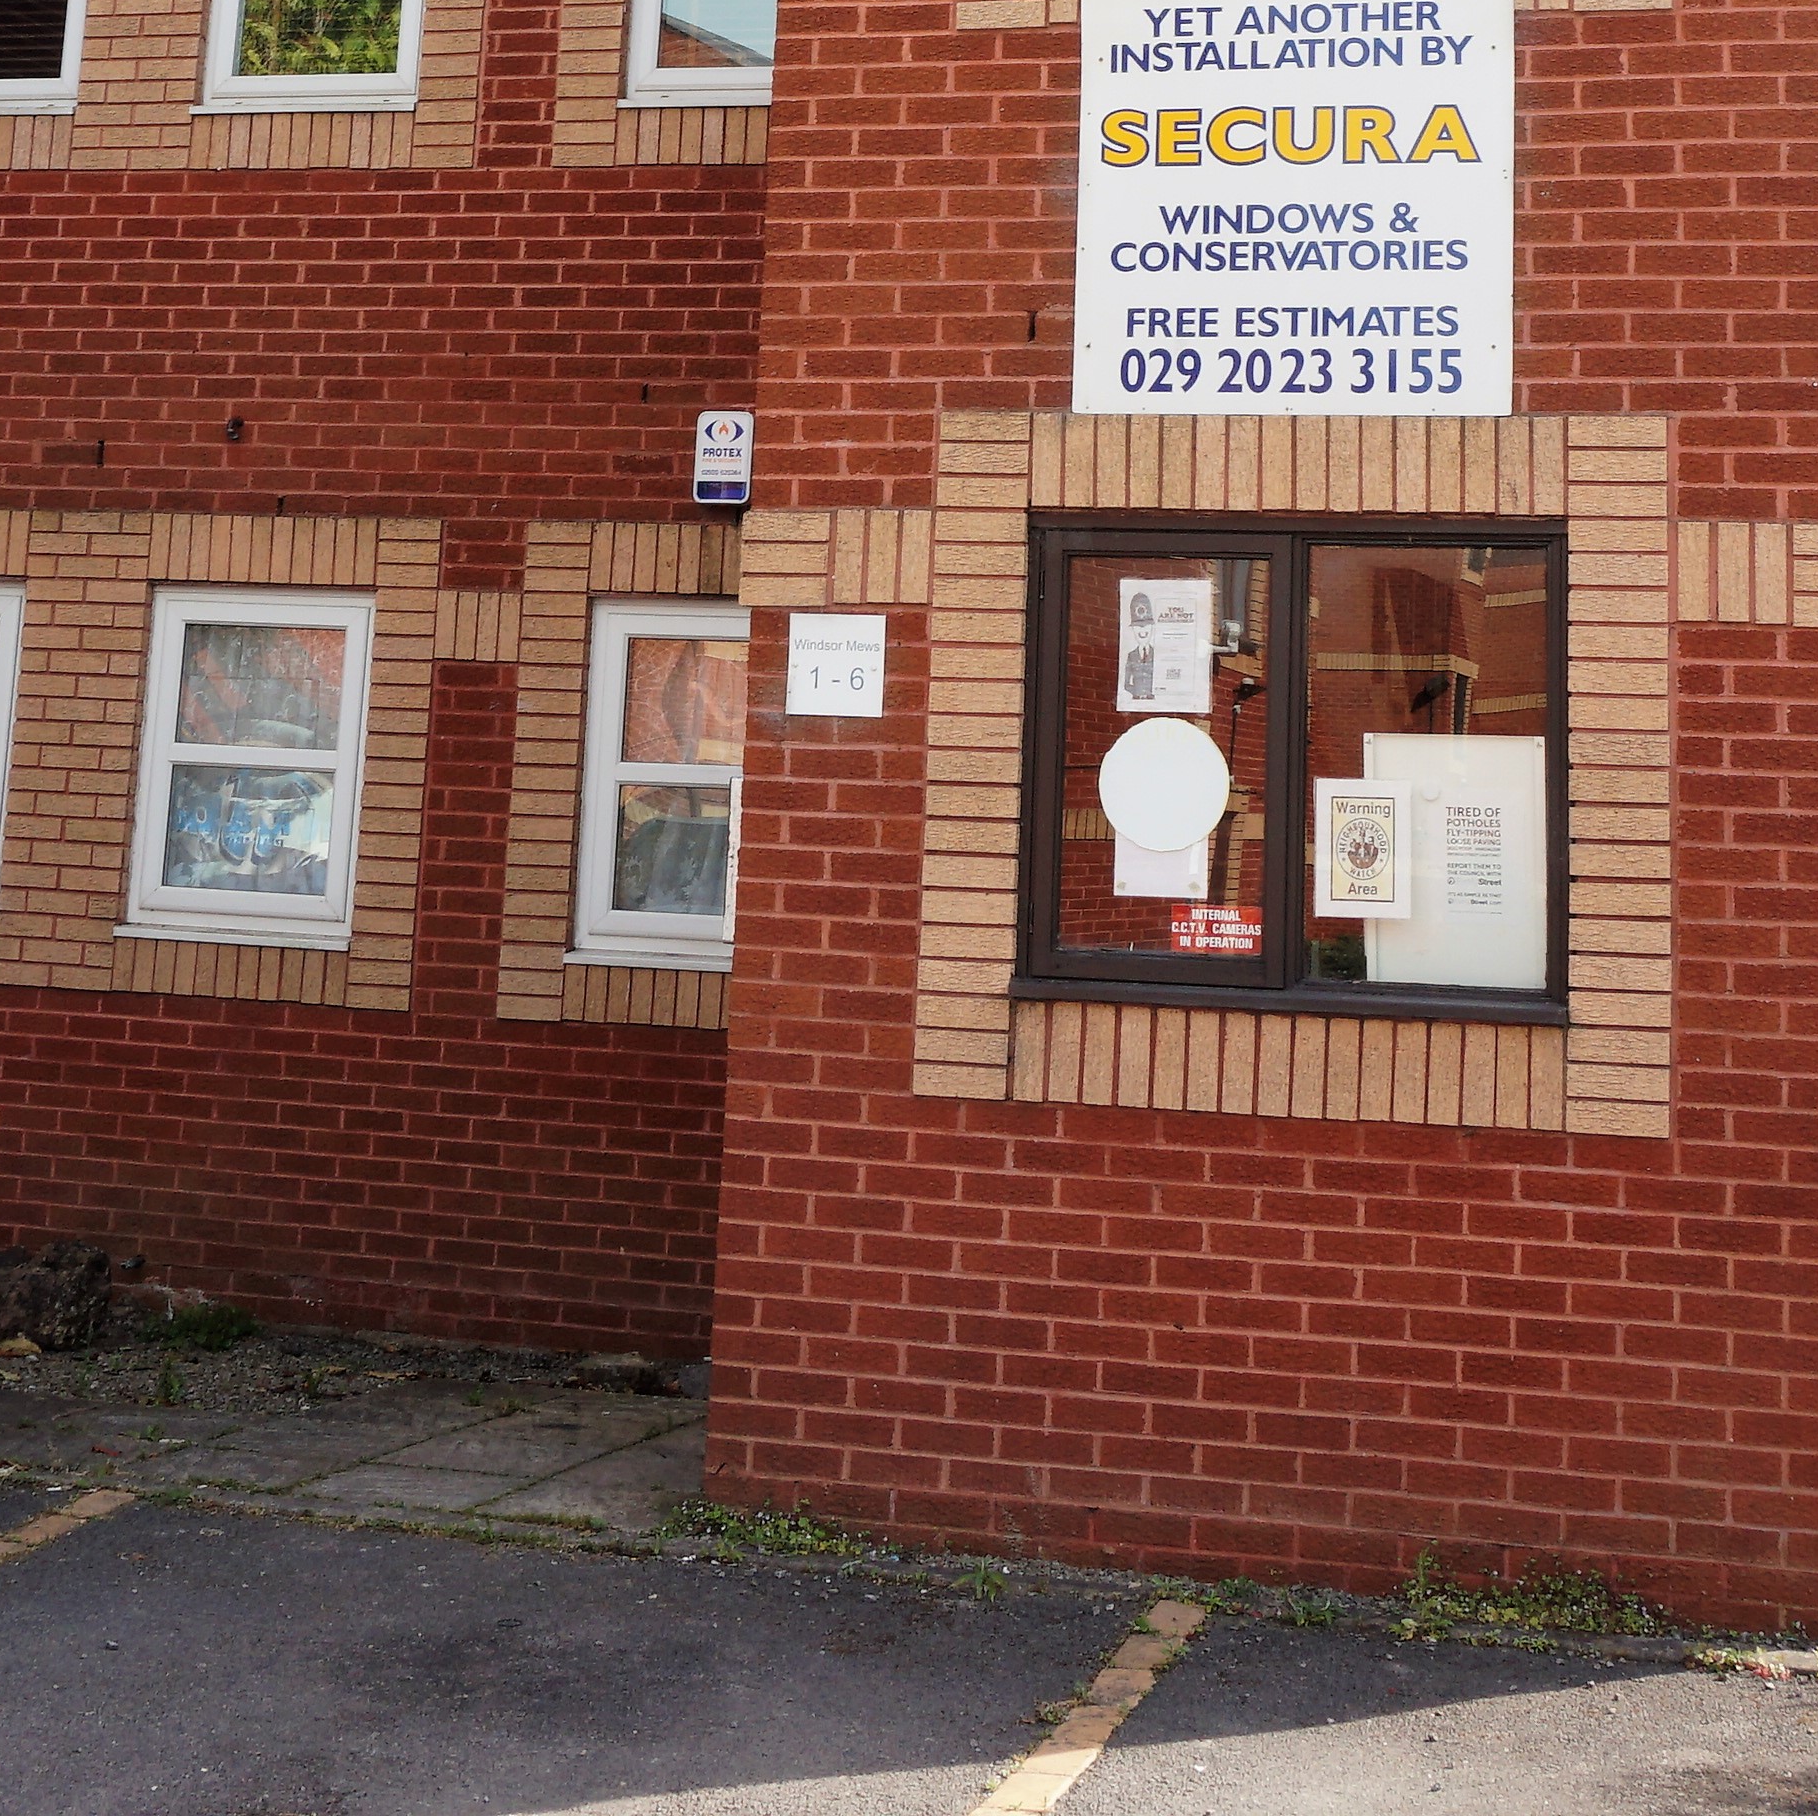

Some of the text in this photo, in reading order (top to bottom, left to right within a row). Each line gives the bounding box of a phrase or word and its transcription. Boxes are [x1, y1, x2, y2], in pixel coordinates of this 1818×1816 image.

[1144, 1, 1441, 38] YET ANOTHER
[1110, 34, 1473, 73] INSTALLATION BY
[1100, 104, 1481, 167] SECURA
[1159, 202, 1419, 235] WINDOWS &
[1110, 239, 1469, 273] CONSERVATORIES
[1126, 306, 1459, 338] FREE ESTIMATES
[1120, 348, 1202, 394] 029
[1350, 348, 1462, 394] 3155
[702, 447, 742, 457] PROTEX
[794, 638, 880, 652] Windsor Mews
[810, 666, 819, 689] 1
[850, 667, 865, 691] 6
[1335, 801, 1391, 818] Warning
[1445, 806, 1501, 817] TIRED OF
[1446, 818, 1501, 827] POTHOLES
[1446, 828, 1501, 837] FLY-TIPPING
[1349, 866, 1377, 878] WATCH
[1347, 882, 1378, 895] Area
[1191, 909, 1241, 921] INTERNAL
[1171, 922, 1262, 936] C.C.T.V. CAMERAS
[1179, 935, 1253, 949] IN OPERATION
